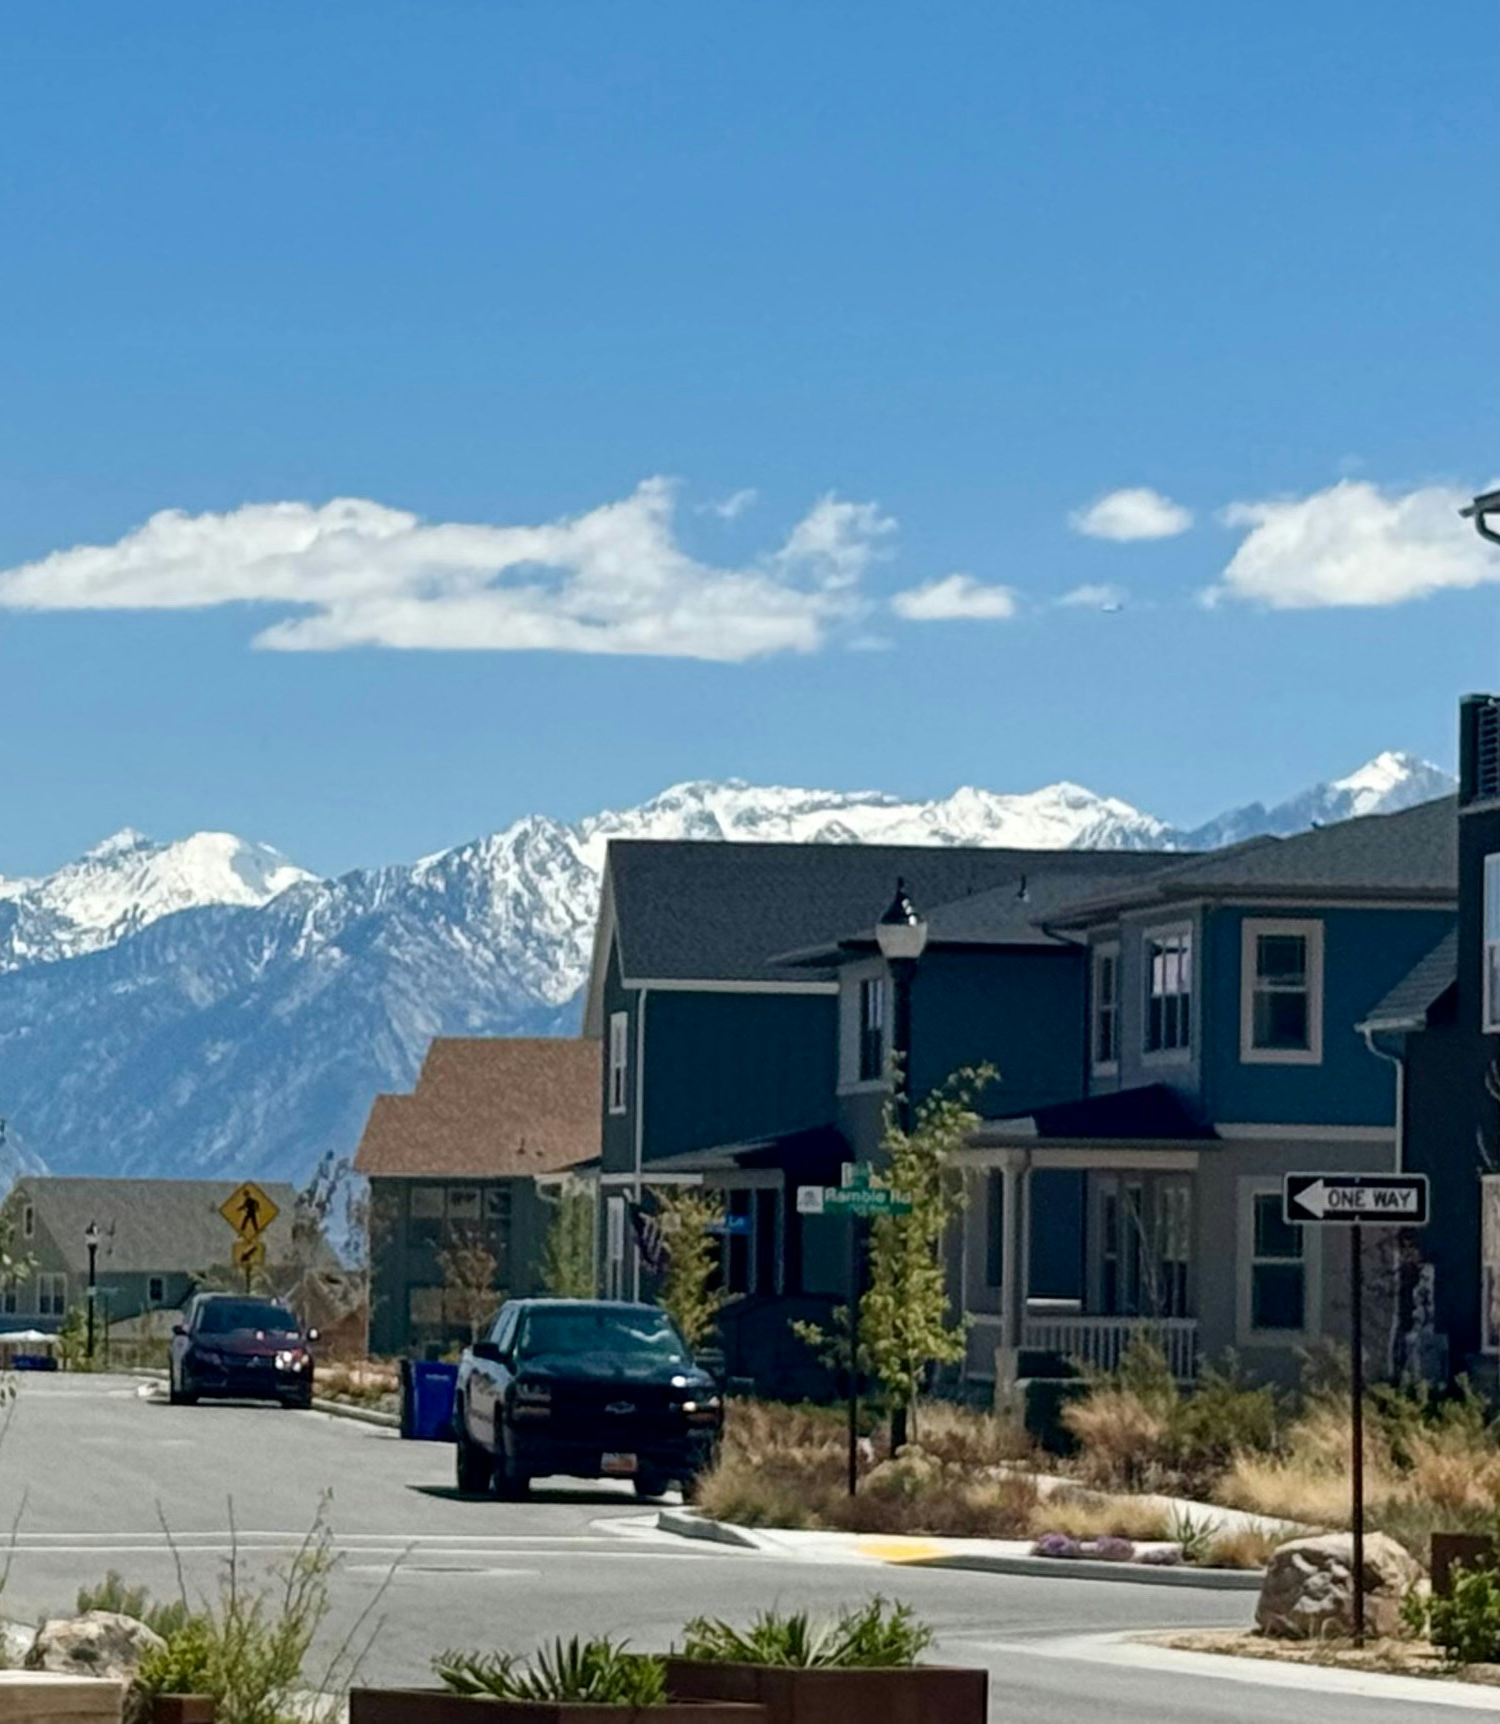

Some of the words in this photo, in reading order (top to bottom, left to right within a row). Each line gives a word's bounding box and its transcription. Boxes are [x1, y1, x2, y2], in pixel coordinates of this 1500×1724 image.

[825, 1186, 886, 1204] Ramble
[890, 1187, 911, 1205] Rd
[1328, 1189, 1366, 1208] ONE
[1372, 1189, 1412, 1208] WAY
